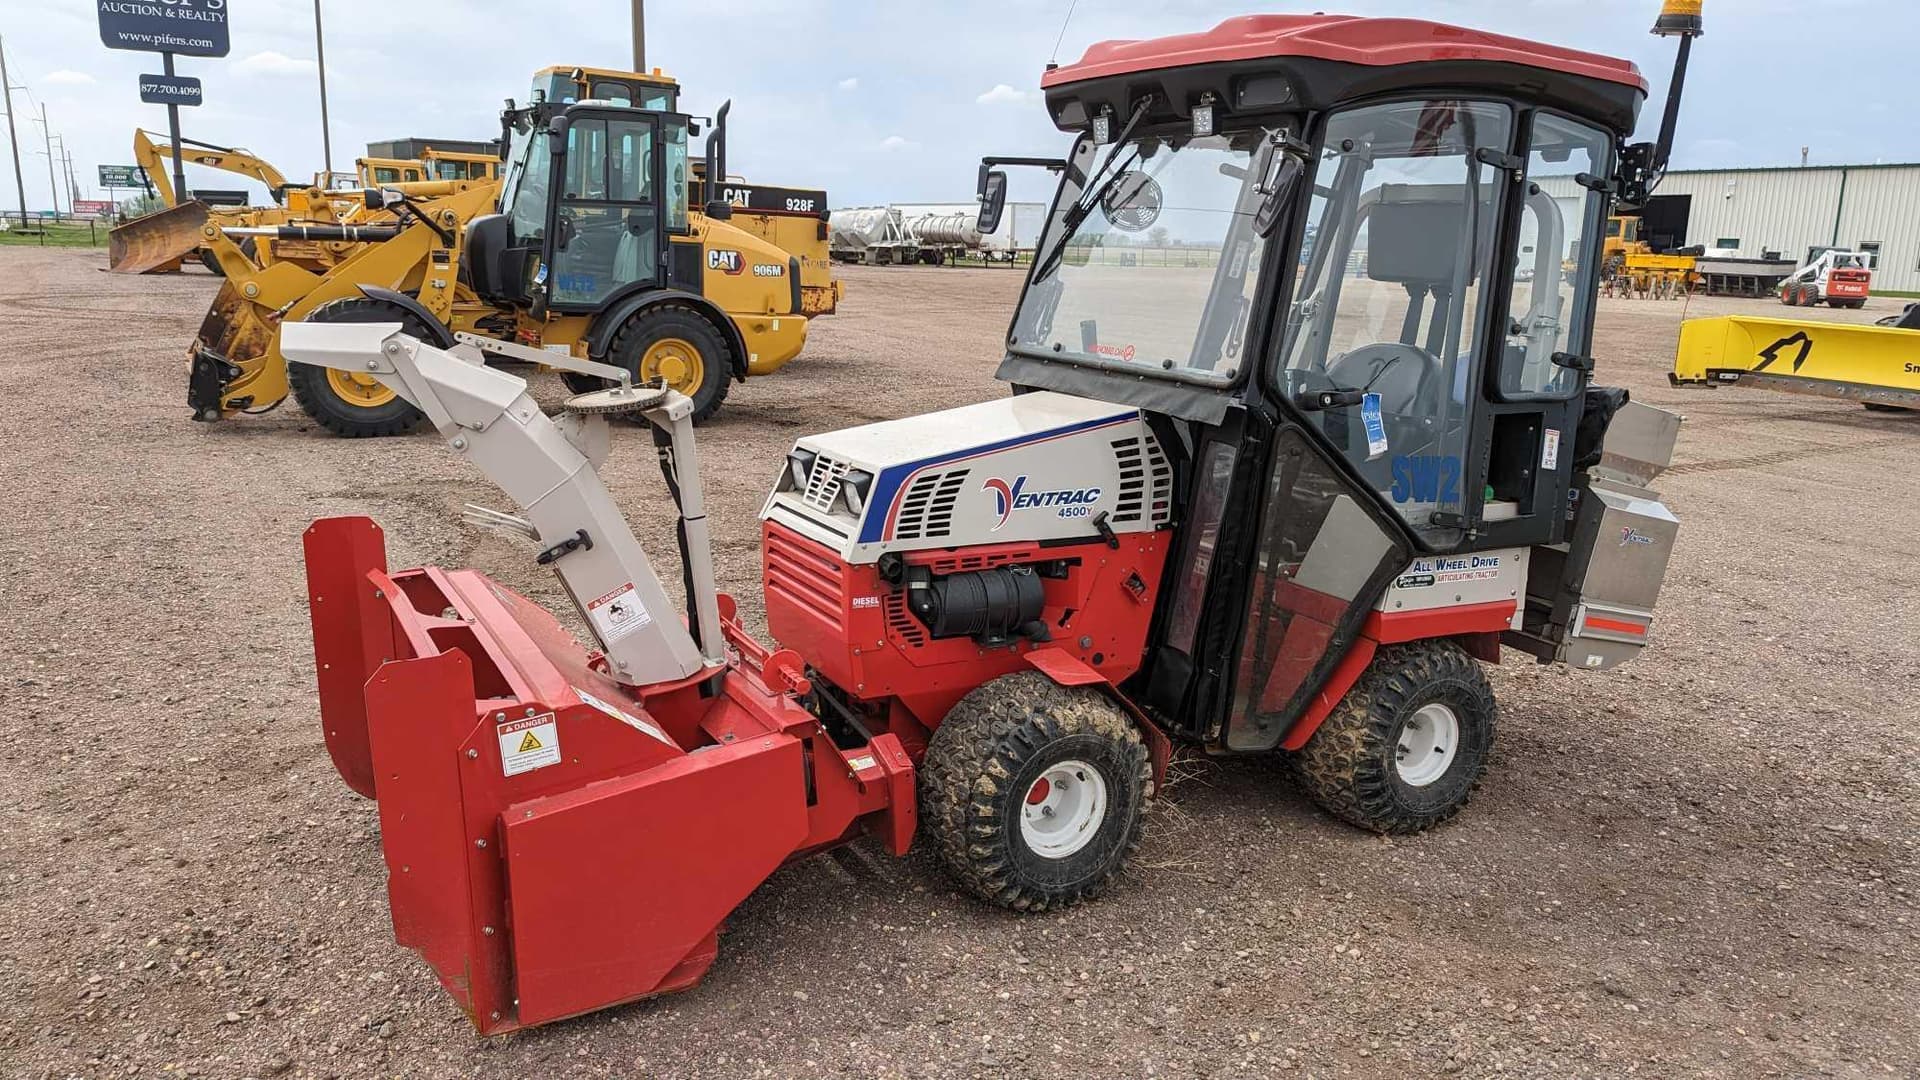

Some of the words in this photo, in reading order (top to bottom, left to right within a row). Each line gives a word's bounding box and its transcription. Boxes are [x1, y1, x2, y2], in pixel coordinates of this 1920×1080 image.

[101, 2, 162, 17] AUCTION
[165, 8, 175, 18] &
[179, 10, 225, 23] REALTY
[118, 31, 213, 48] www.pifers.com
[141, 84, 201, 96] 877.700.4099
[723, 188, 752, 208] CAT
[786, 198, 814, 211] 928F
[708, 250, 737, 271] CAT
[753, 264, 782, 277] 906M
[1391, 456, 1460, 503] SW2
[981, 475, 1101, 531] VENTRAC
[1058, 506, 1093, 518] 4500Y
[1413, 560, 1433, 573] ALL
[1436, 559, 1467, 571] WHEEL
[1471, 556, 1499, 568] DRIVE
[1438, 571, 1473, 582] ARTICULATING
[1475, 569, 1498, 578] TRACTOR
[600, 586, 627, 602] DANGER
[852, 596, 879, 605] DIESEL
[514, 716, 548, 730] DANGER
